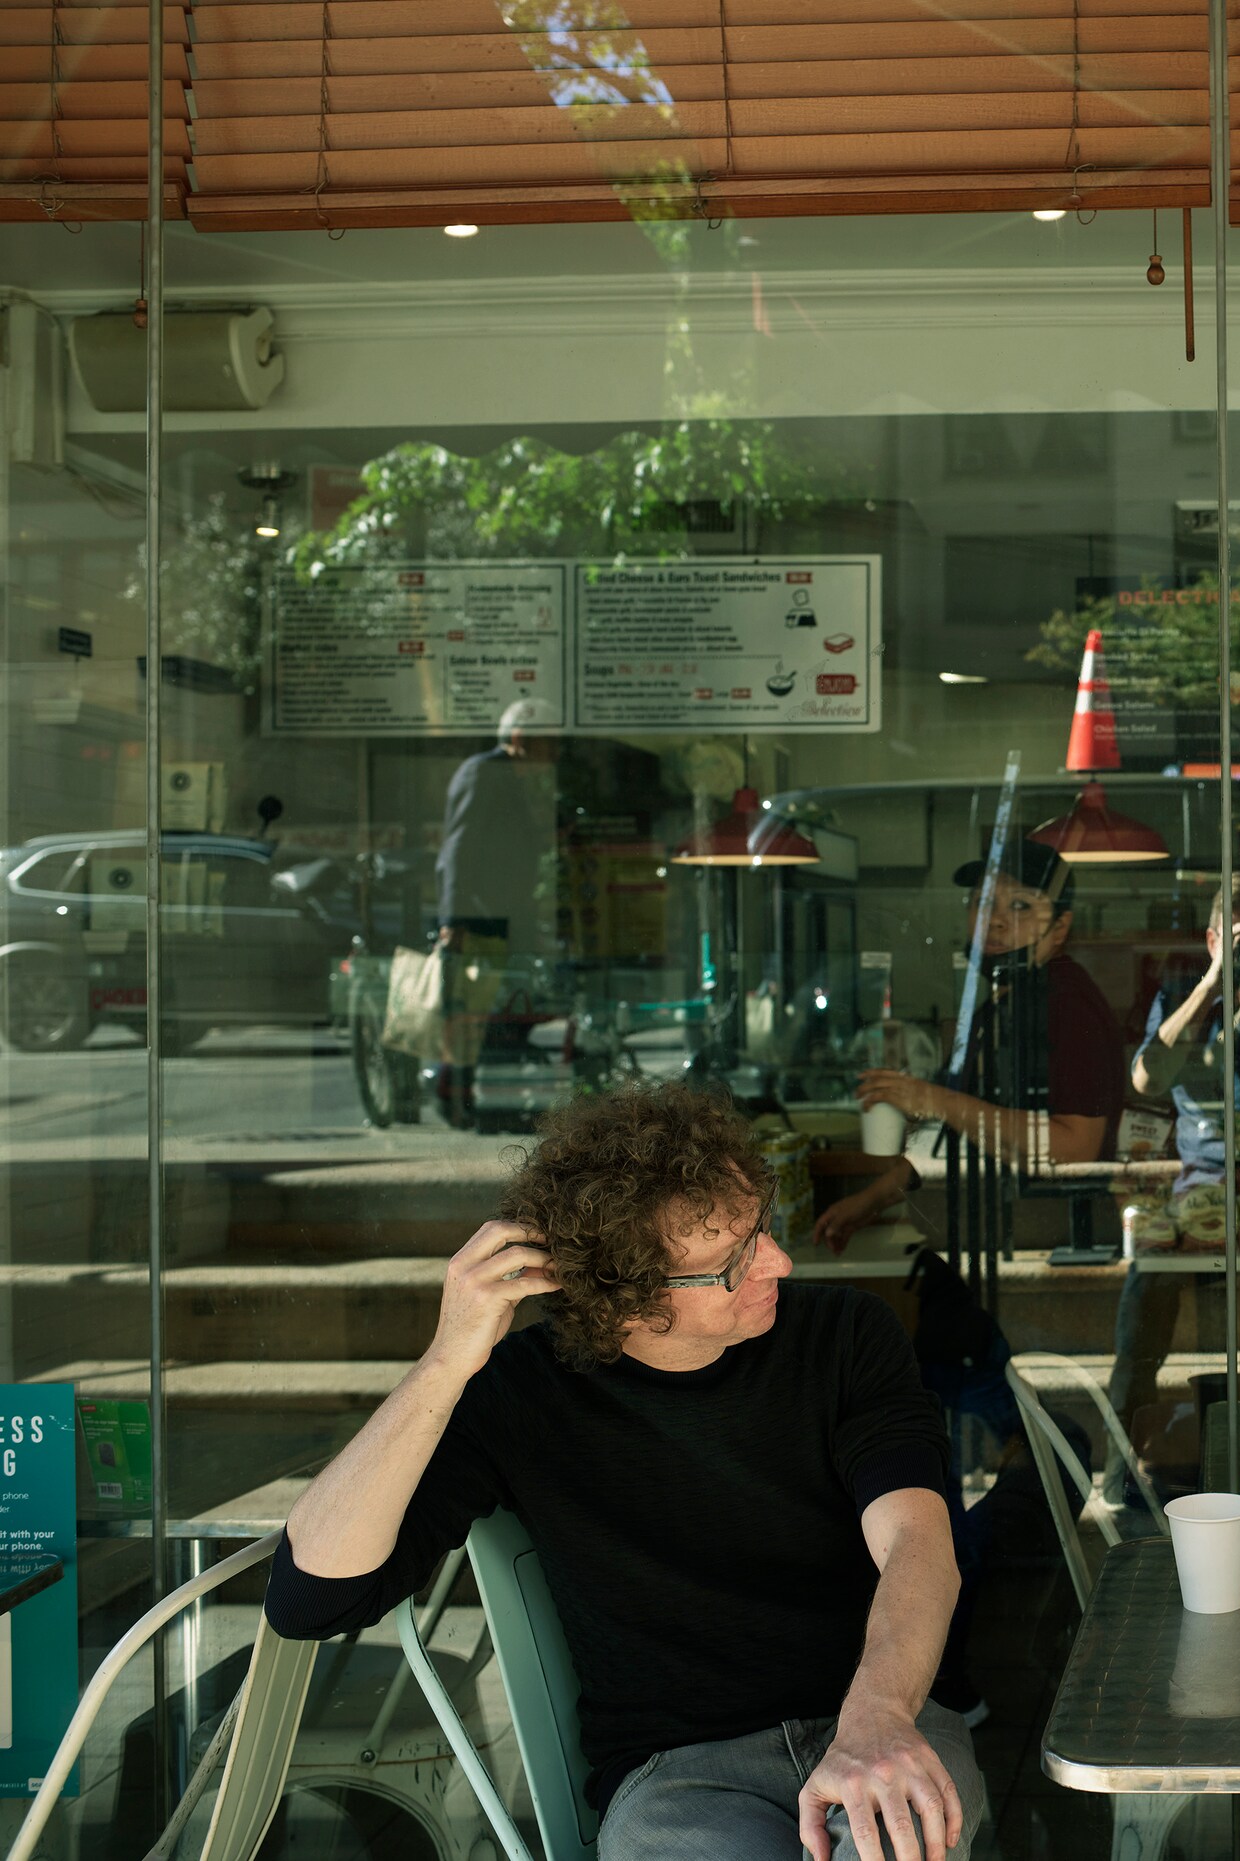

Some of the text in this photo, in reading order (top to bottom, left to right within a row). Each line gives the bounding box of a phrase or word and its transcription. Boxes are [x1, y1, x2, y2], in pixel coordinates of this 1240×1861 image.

[619, 573, 654, 583] Cheese
[658, 573, 666, 582] &
[723, 572, 781, 583] Sandwiches
[4, 1449, 16, 1477] G
[2, 1491, 29, 1500] phone
[10, 1530, 31, 1539] with
[33, 1531, 55, 1540] your
[11, 1542, 44, 1552] phone.
